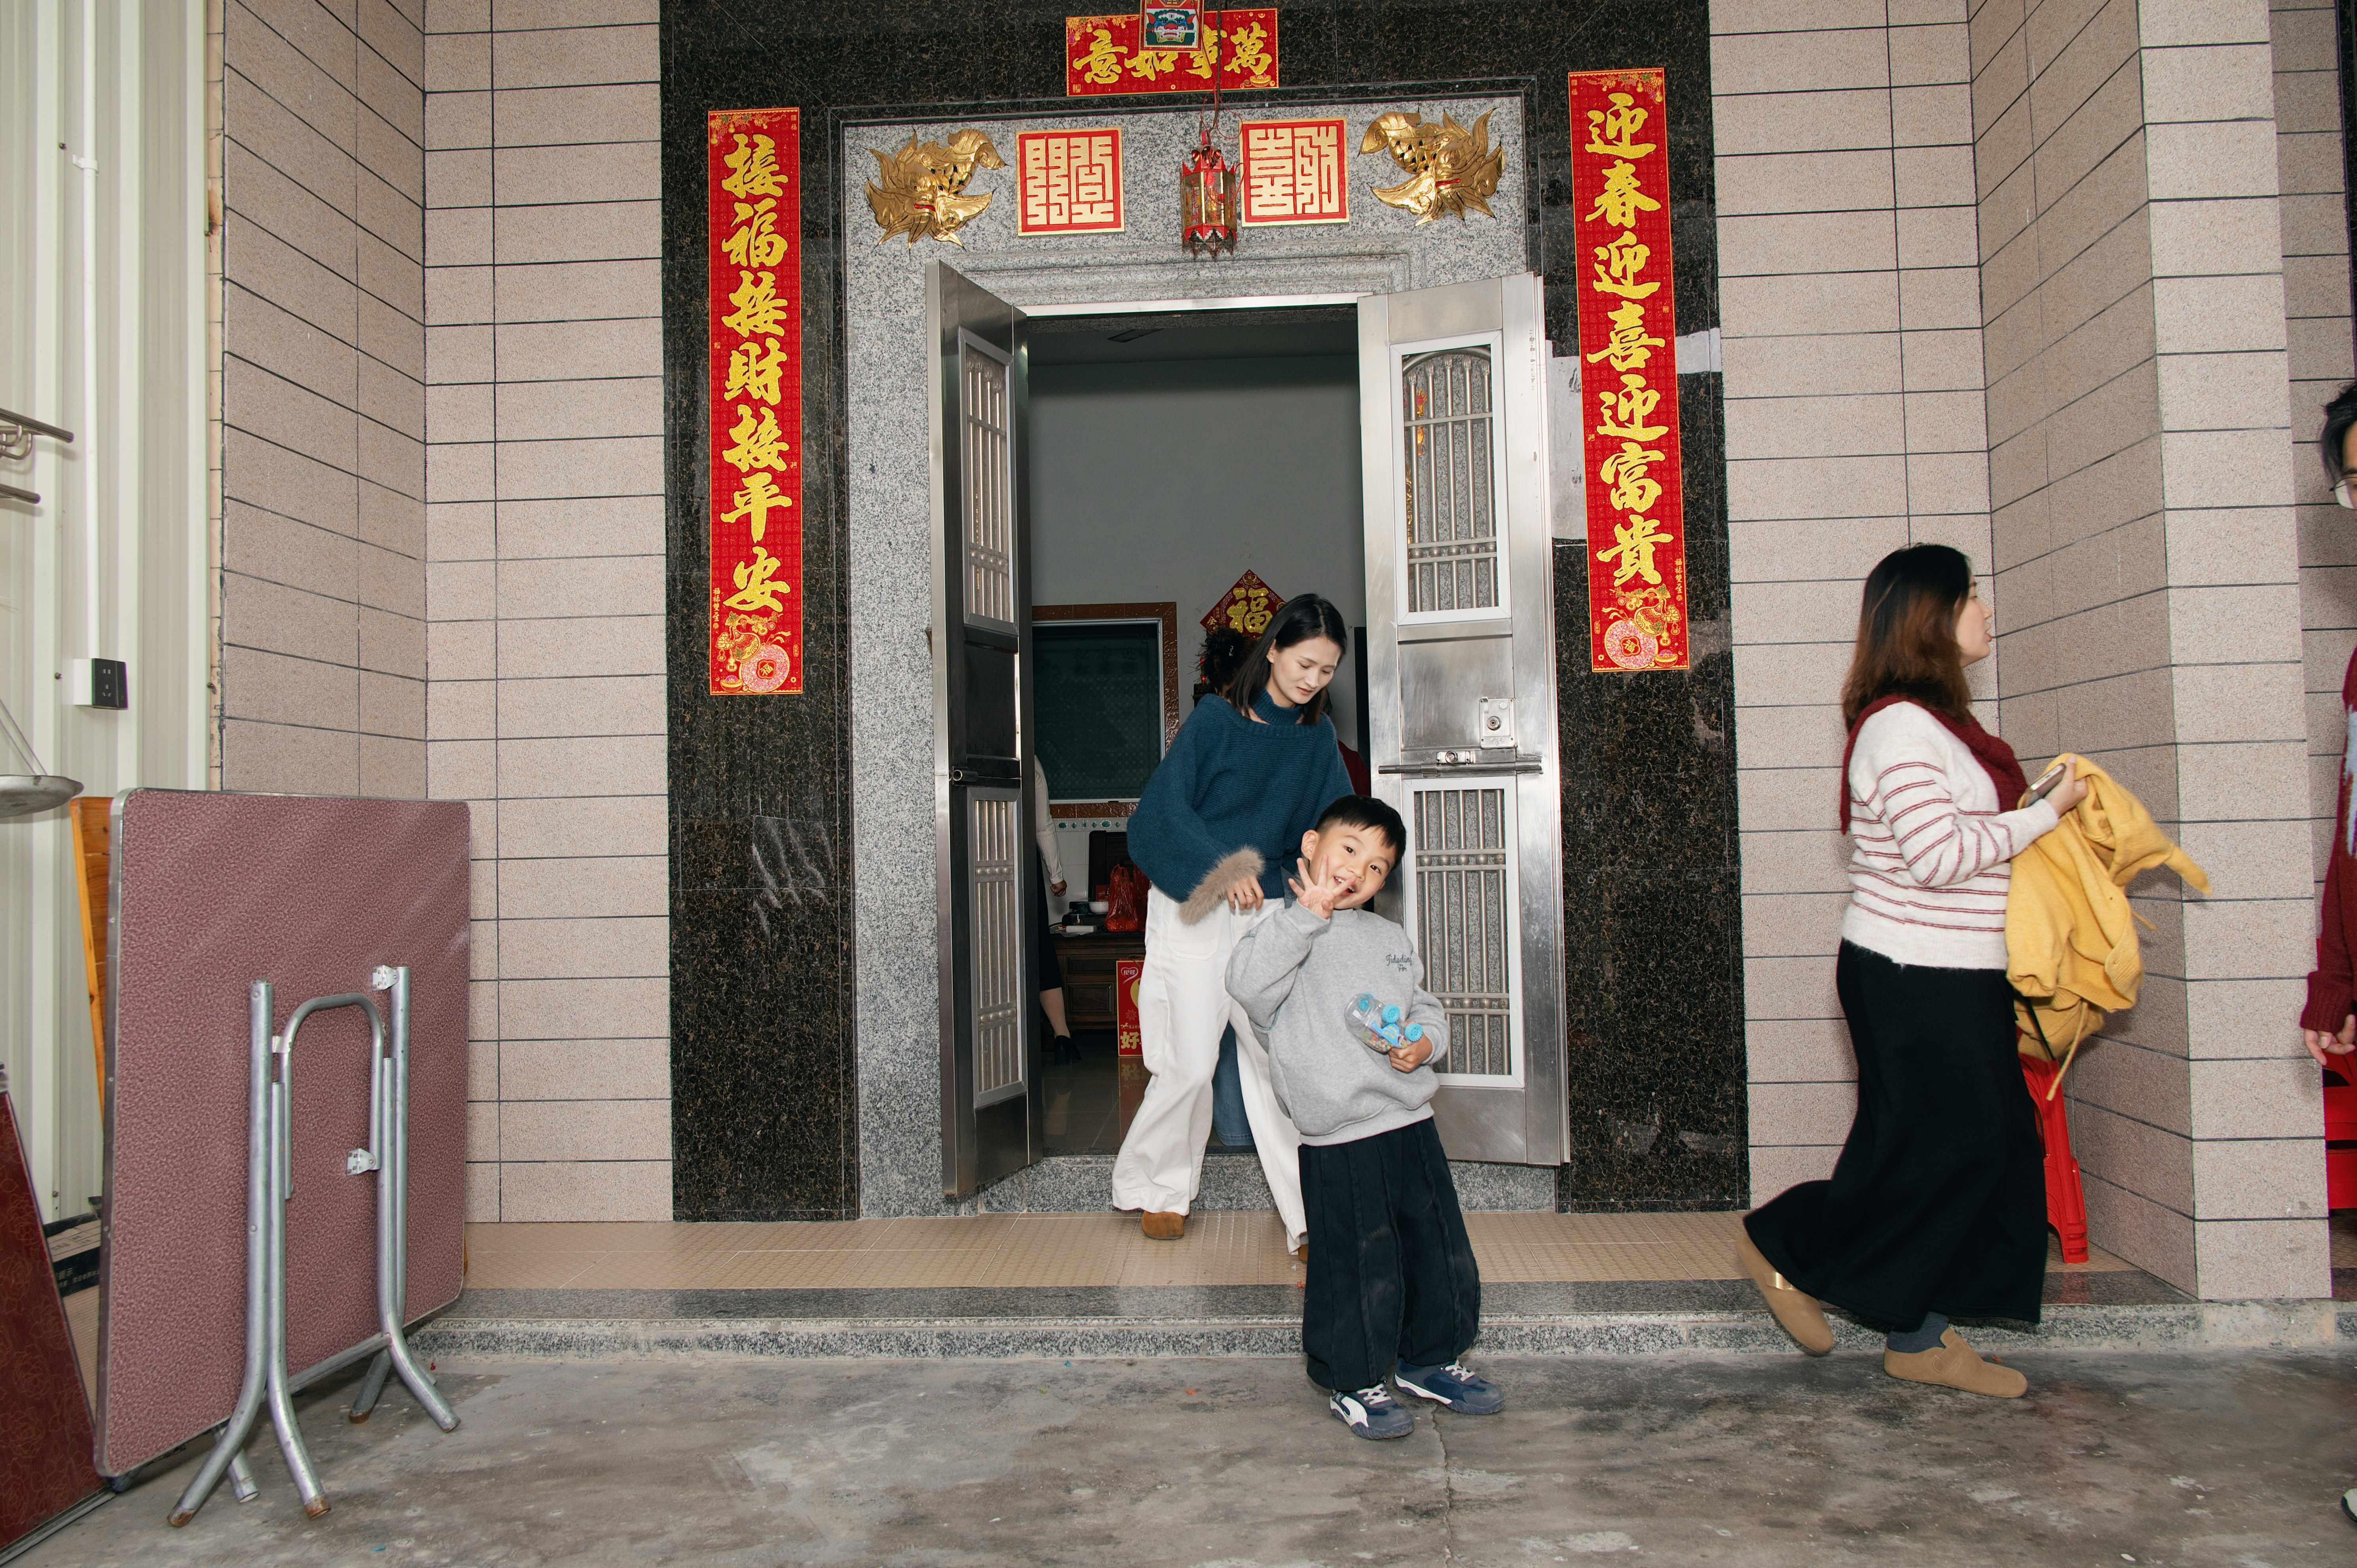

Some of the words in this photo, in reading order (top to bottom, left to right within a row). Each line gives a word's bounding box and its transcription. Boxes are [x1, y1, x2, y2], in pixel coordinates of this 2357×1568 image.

[1584, 92, 1674, 587] 迎春迎喜迎富貴
[720, 133, 792, 612] 接福接財接平安
[1226, 587, 1273, 634] 福
[760, 663, 773, 676] 福
[1623, 639, 1638, 653] 福
